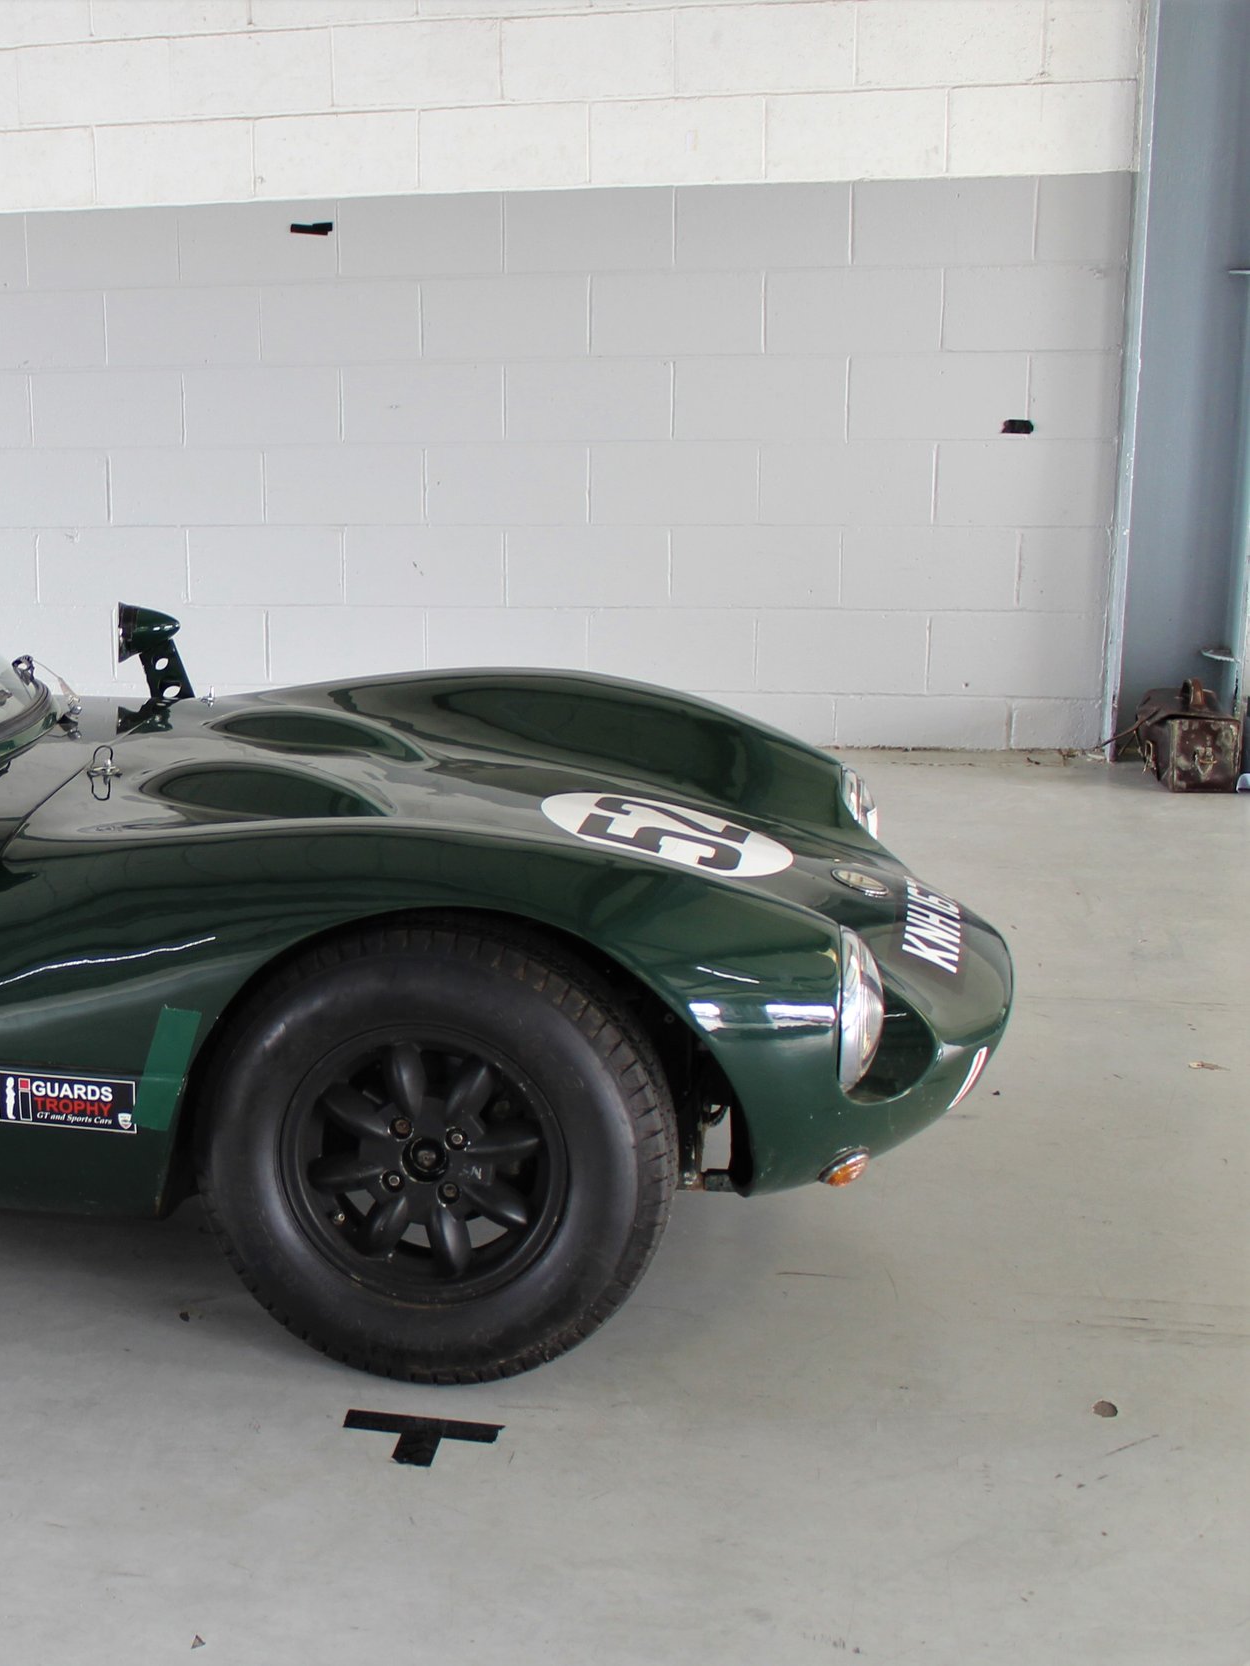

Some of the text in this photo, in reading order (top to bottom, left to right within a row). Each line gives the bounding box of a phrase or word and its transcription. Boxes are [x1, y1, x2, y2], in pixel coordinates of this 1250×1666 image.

[577, 796, 751, 870] 52
[32, 1081, 113, 1102] GUARDS
[34, 1097, 112, 1117] TROPHY
[37, 1111, 50, 1119] GT
[51, 1112, 65, 1121] and
[67, 1113, 92, 1124] Sports
[93, 1116, 112, 1125] Cars
